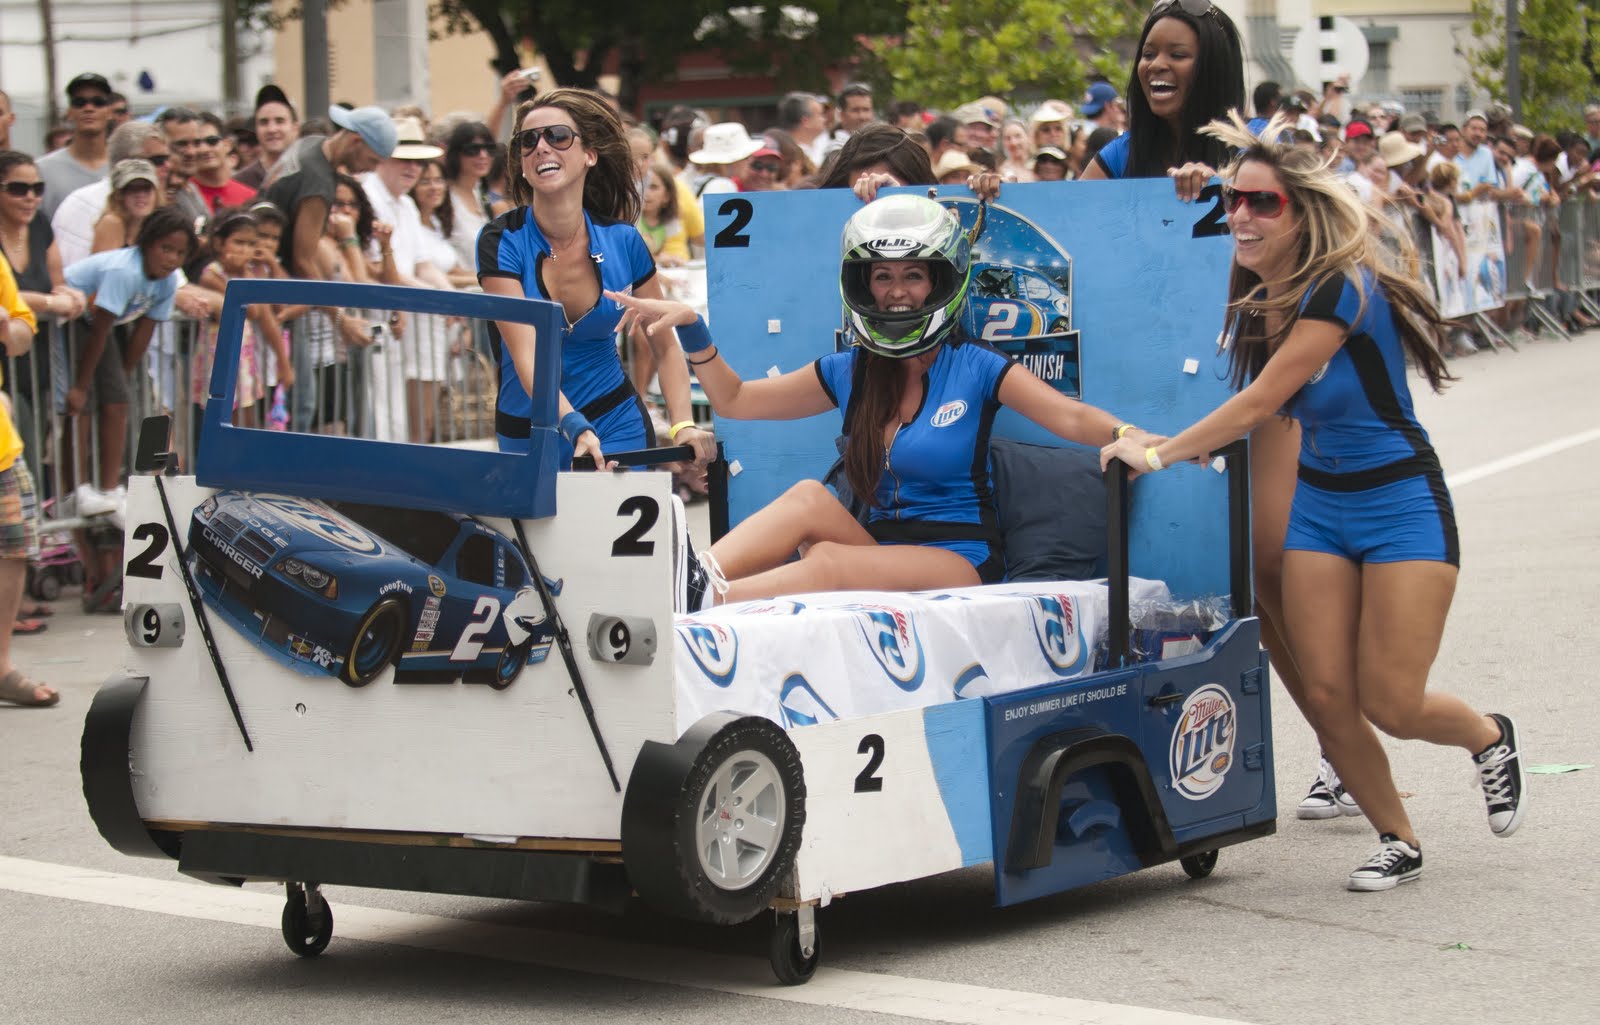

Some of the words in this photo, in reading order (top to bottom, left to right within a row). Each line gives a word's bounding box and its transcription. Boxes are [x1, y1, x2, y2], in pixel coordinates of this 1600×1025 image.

[714, 198, 754, 249] 2
[1192, 184, 1231, 239] 2
[875, 238, 912, 248] HJC
[981, 302, 1019, 339] 2
[1022, 354, 1065, 380] FINISH
[226, 505, 289, 549] DODGE
[611, 495, 660, 558] 2
[126, 522, 169, 580] 2
[202, 527, 264, 580] CHARGER
[143, 608, 161, 644] 9
[450, 595, 501, 661] 2
[609, 621, 631, 661] 9
[1005, 706, 1029, 721] ENJOY
[1029, 699, 1060, 715] SUMMER
[1061, 694, 1078, 708] LIKE
[1078, 693, 1086, 704] IT
[1086, 687, 1116, 702] SHOULD
[1117, 684, 1127, 696] BE
[1188, 699, 1224, 726] Miller
[854, 733, 885, 793] 2
[1177, 708, 1233, 781] Lite
